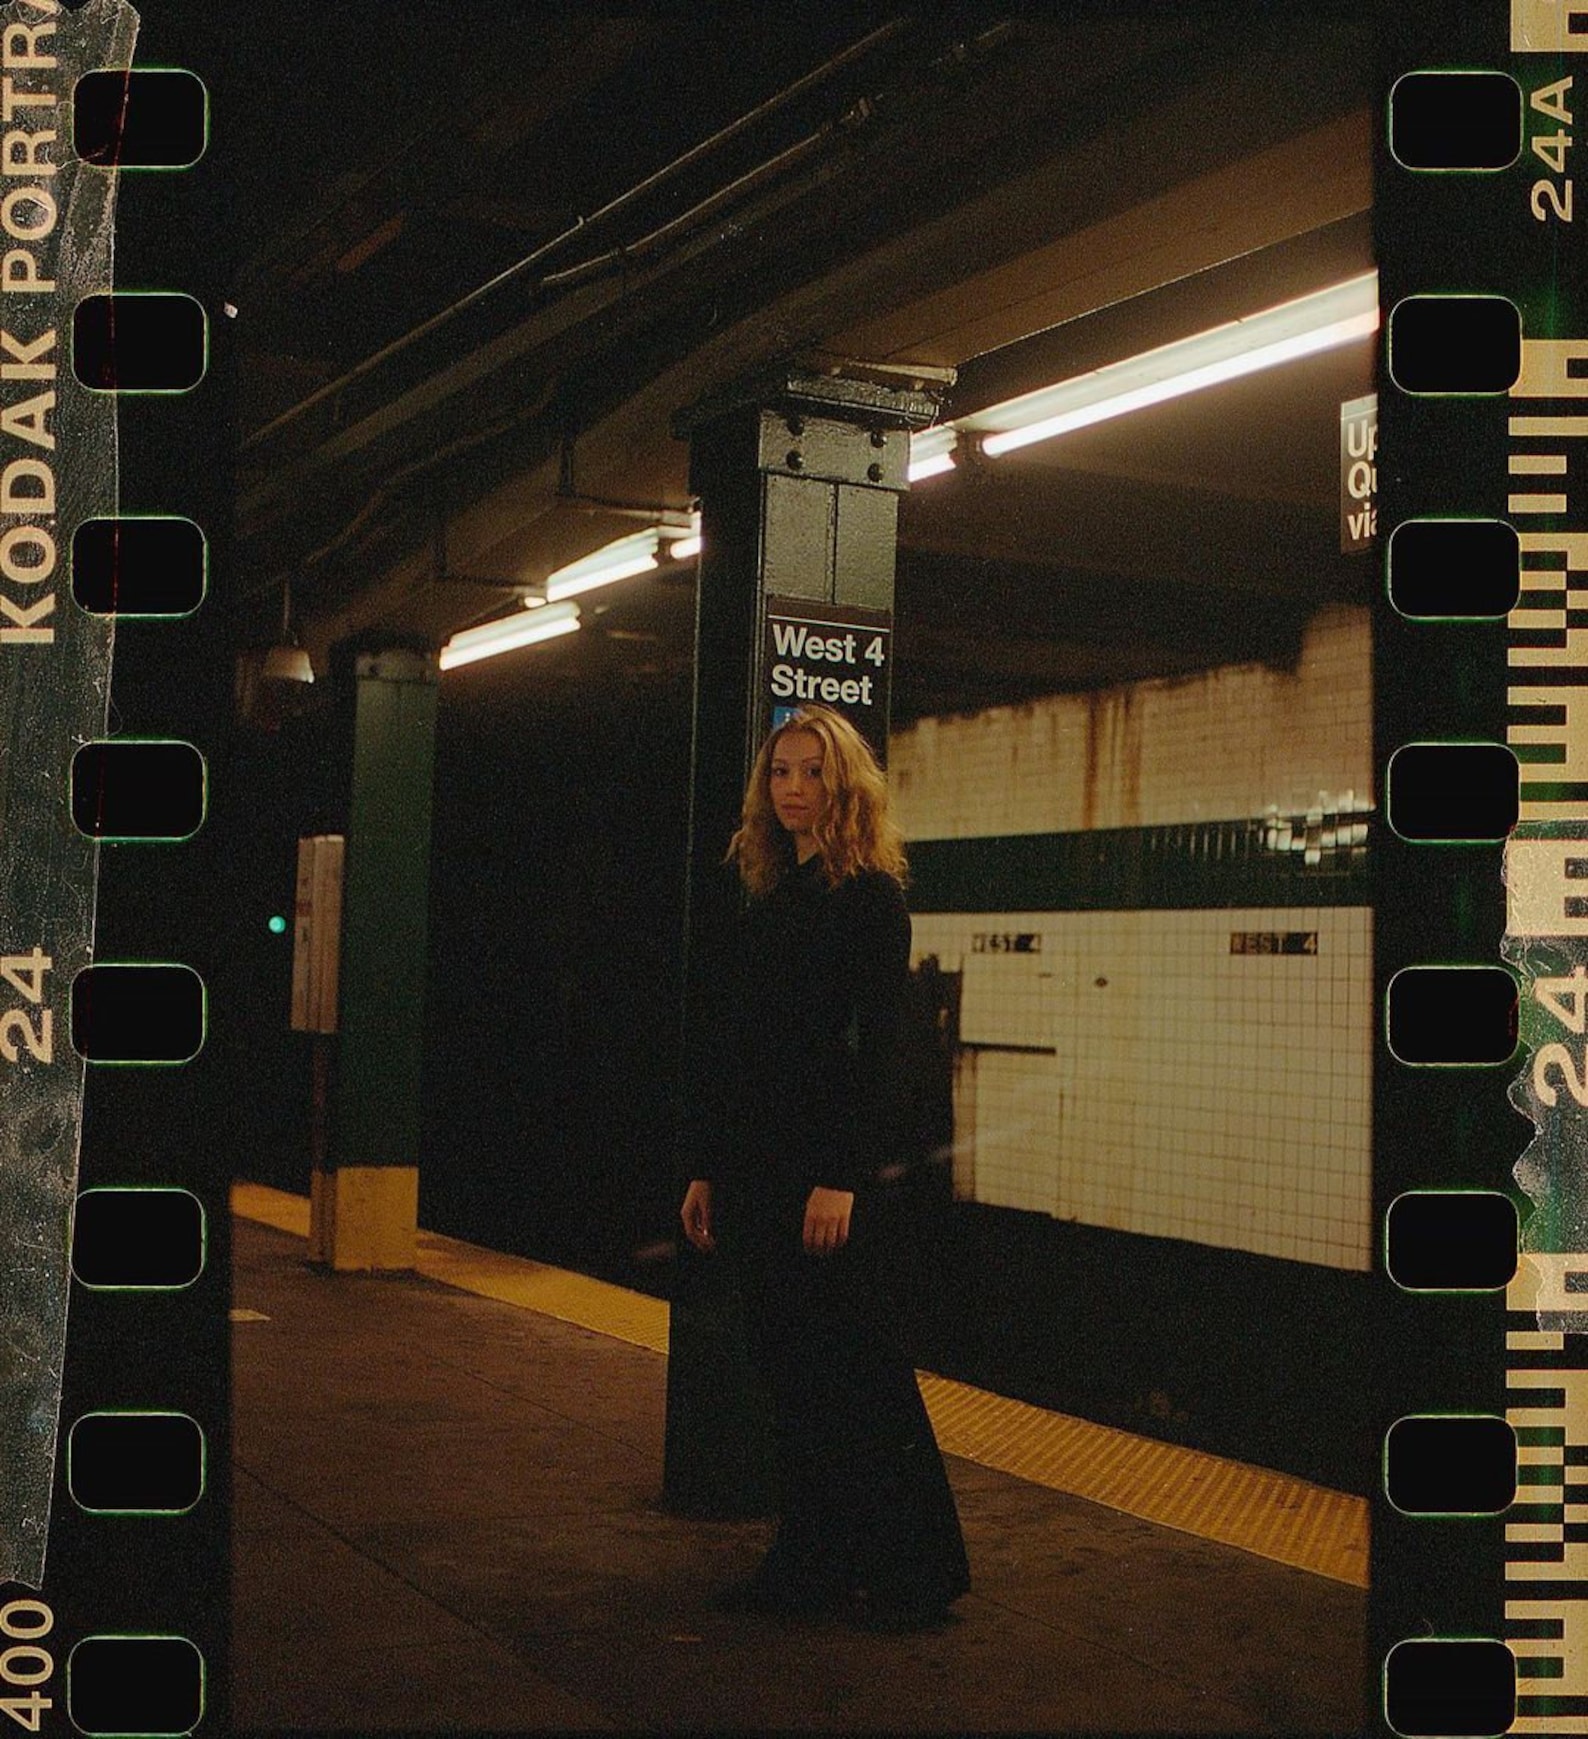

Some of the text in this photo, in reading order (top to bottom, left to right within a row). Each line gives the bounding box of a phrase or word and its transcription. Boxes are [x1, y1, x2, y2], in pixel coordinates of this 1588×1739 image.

[1530, 75, 1573, 223] 24A
[0, 0, 58, 644] KODAK PORTR
[771, 664, 873, 705] Street
[773, 624, 885, 667] West 4
[0, 946, 53, 1065] 24
[1303, 933, 1316, 954] 4
[1534, 966, 1588, 1108] 24
[0, 1600, 54, 1731] 400
